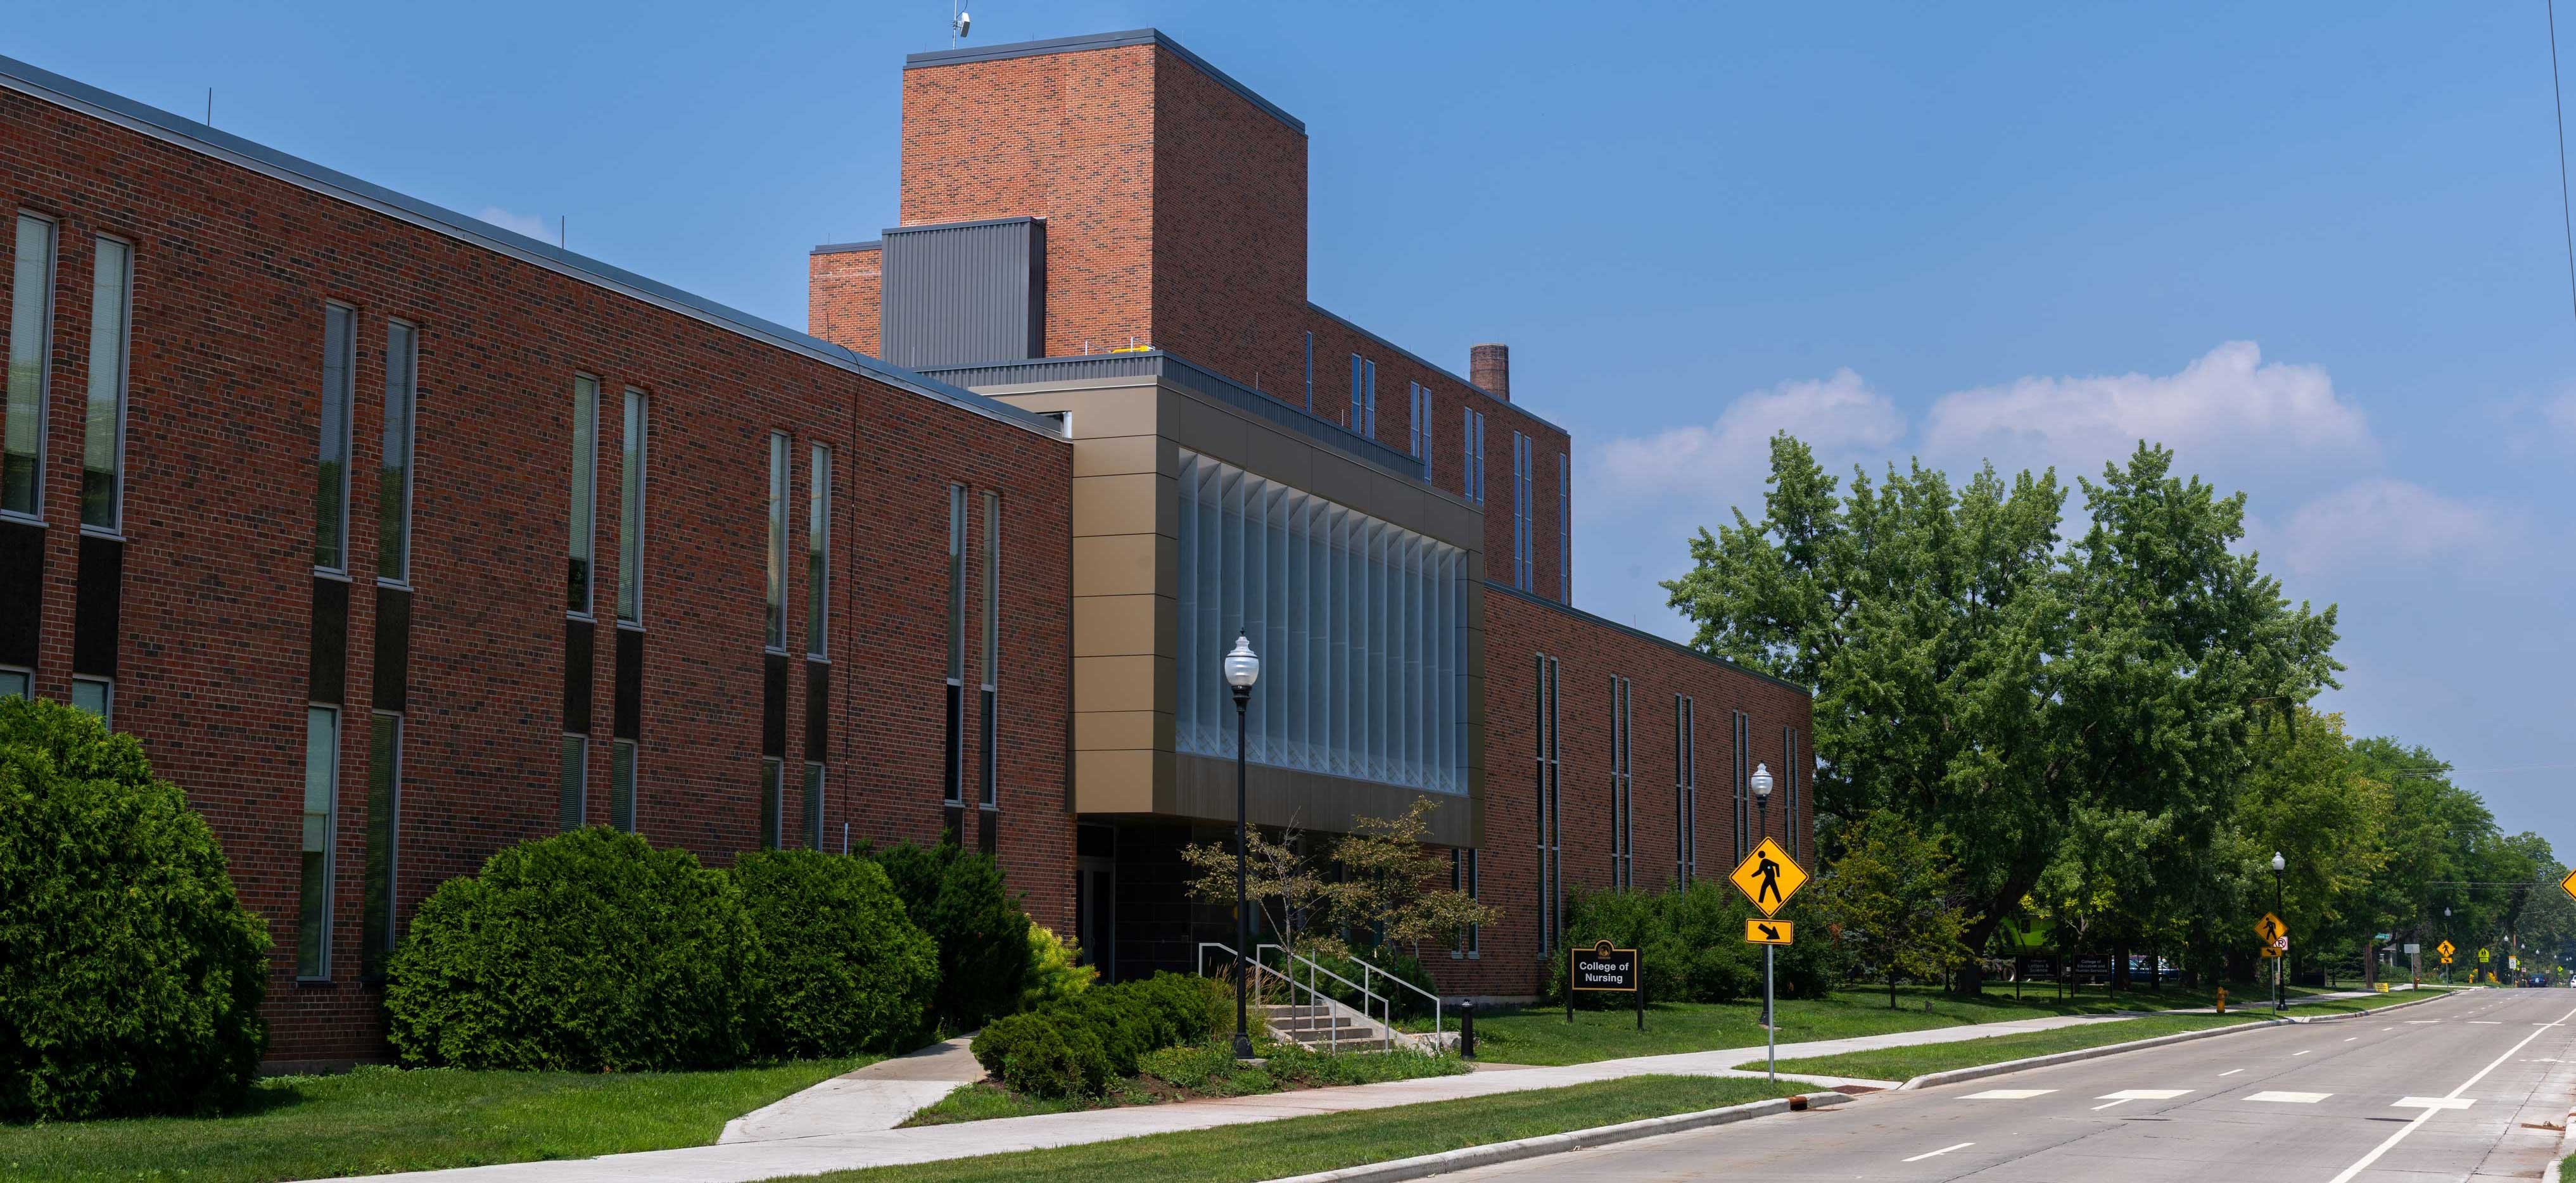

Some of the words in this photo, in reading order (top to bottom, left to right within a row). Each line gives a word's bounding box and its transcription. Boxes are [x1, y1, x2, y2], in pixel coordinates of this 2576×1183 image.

[1579, 961, 1616, 972] College
[1619, 962, 1629, 971] of
[1585, 973, 1623, 984] Nursing
